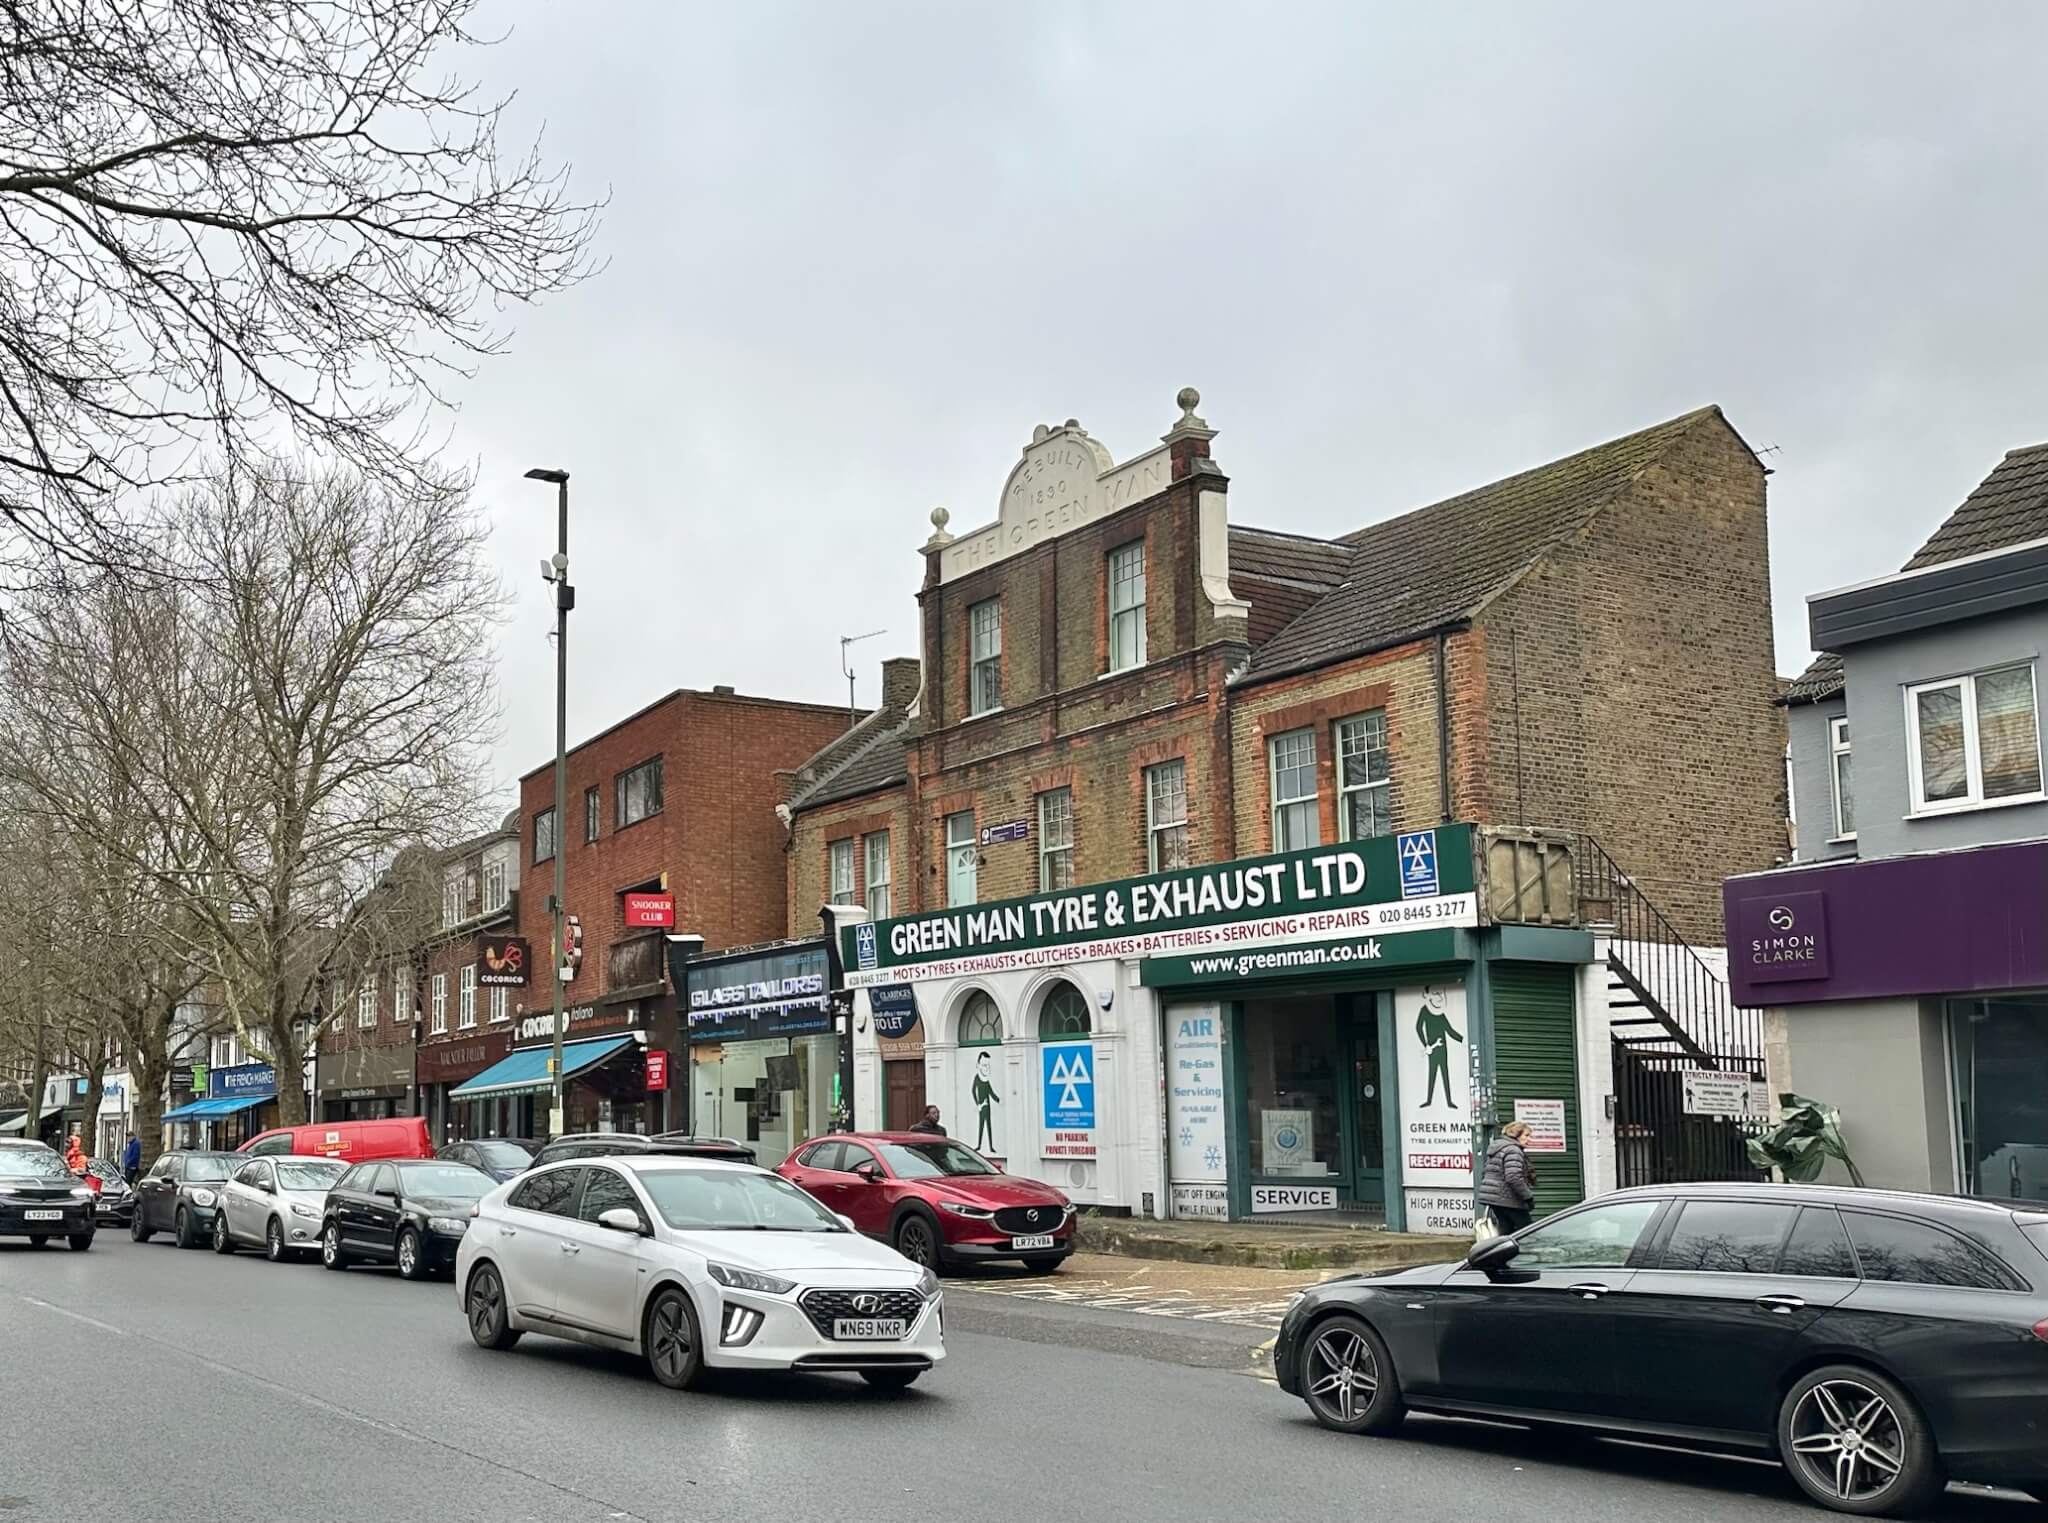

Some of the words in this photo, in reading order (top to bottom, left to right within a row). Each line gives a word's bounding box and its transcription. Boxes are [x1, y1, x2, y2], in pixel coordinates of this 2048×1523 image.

[1012, 450, 1086, 497] REBUILT
[951, 536, 997, 574] THE
[1009, 495, 1090, 545] GREEN
[1105, 461, 1161, 511] MAN
[631, 900, 672, 910] SNOOKER
[890, 915, 962, 956] GREEN
[966, 905, 1026, 946] MAN
[1029, 893, 1098, 937] TYRE
[1104, 890, 1126, 927] &
[1131, 862, 1286, 924] EXHAUST
[1294, 851, 1366, 901] LTD
[640, 912, 664, 921] CLUB
[1379, 909, 1400, 924] 020
[1403, 905, 1432, 921] 8445
[1435, 900, 1466, 918] 3277
[927, 962, 956, 977] TYRES
[963, 954, 1017, 972] EXHAUSTS
[1024, 946, 1081, 966] CLUTCHES
[1089, 939, 1134, 958] BRAKES
[1144, 930, 1213, 951] BATTERIES
[1223, 919, 1297, 942] SERVICING
[1308, 910, 1370, 932] REPAIRS
[1752, 935, 1814, 951] SIMON
[1190, 938, 1382, 976] www.greenman.co.uk
[1752, 948, 1815, 964] CLARKE
[481, 974, 524, 984] COCORICO
[690, 985, 745, 1007] GLASS
[746, 973, 823, 1000] TAILORS
[522, 1012, 569, 1038] COCORO
[886, 1016, 903, 1030] LET
[1178, 1018, 1213, 1037] AIR
[1179, 1059, 1215, 1069] Re-Gas
[254, 1070, 276, 1085] MARKET
[1193, 1073, 1200, 1082] &
[1684, 1072, 1712, 1080] STRICTLY
[1174, 1087, 1222, 1099] Servicing
[1410, 1123, 1447, 1133] GREEN
[1055, 1133, 1064, 1142] NO
[1065, 1133, 1089, 1142] PARKING
[1045, 1145, 1067, 1155] PRIVATE
[1068, 1145, 1096, 1155] FORECOUR
[1410, 1155, 1470, 1169] RECEPTION
[1191, 1190, 1203, 1199] OFF
[1205, 1190, 1228, 1200] ENGIN
[1255, 1190, 1332, 1206] SERVICE
[1178, 1205, 1199, 1216] WHILE
[1200, 1205, 1227, 1217] FILLING
[1411, 1198, 1434, 1210] HIGH
[1437, 1199, 1475, 1210] PRESSU
[1426, 1216, 1474, 1229] GREASING
[840, 1321, 873, 1336] WN69
[876, 1321, 901, 1336] NKR
